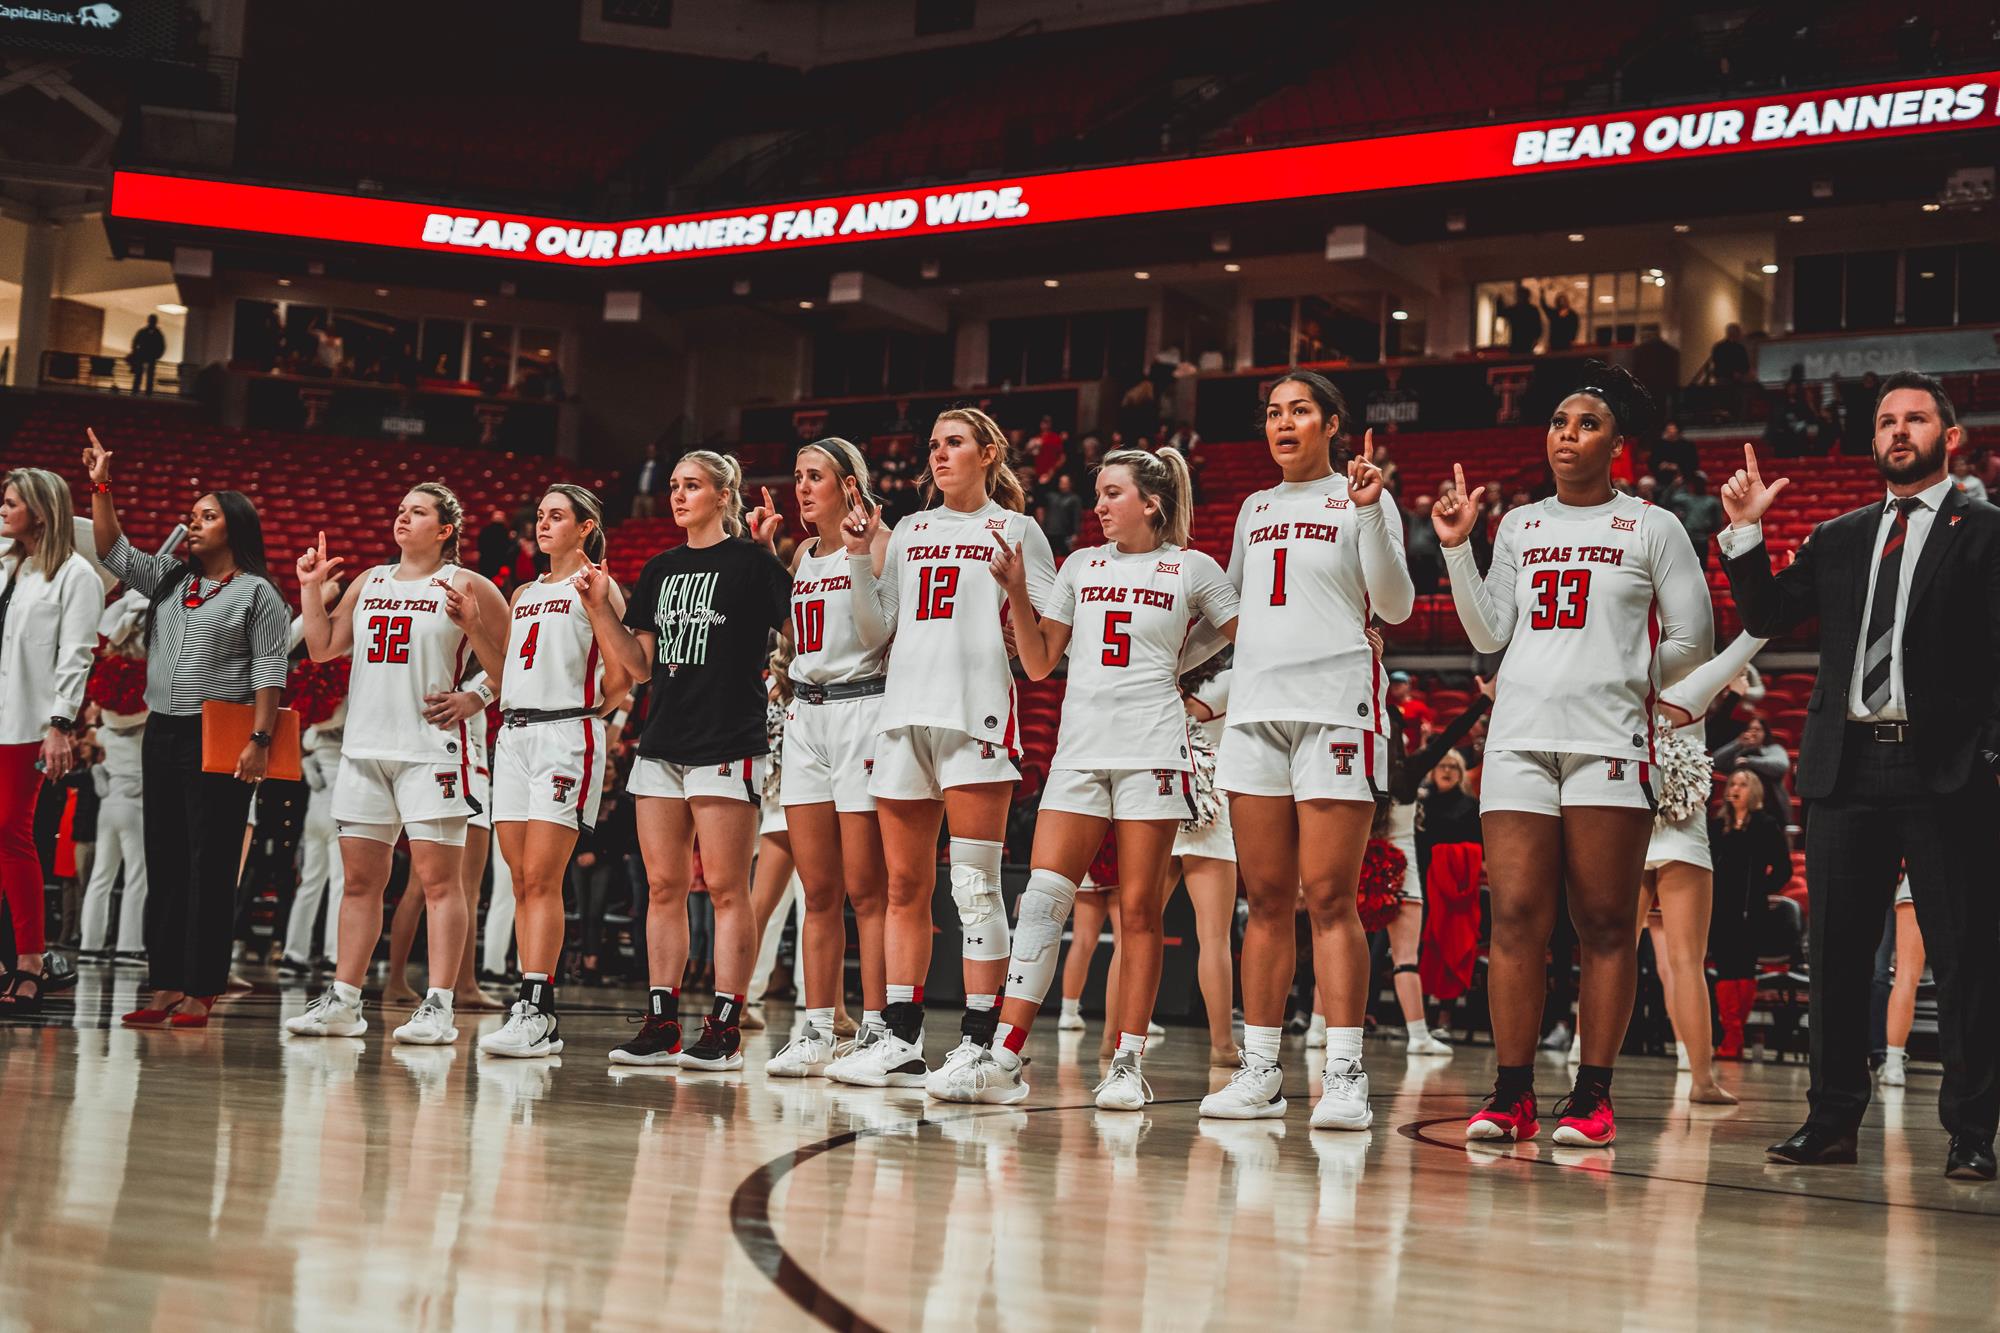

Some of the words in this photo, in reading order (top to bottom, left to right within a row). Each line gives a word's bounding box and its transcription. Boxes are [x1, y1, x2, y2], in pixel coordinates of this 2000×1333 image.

[1512, 121, 1635, 166] BEAR
[1643, 109, 1744, 153] OUR
[1751, 83, 1987, 141] BANNERS
[421, 213, 531, 251] BEAR
[535, 226, 617, 259] OUR
[618, 214, 768, 258] BANNERS
[770, 207, 838, 242] FAR
[839, 198, 919, 235] AND
[925, 186, 1029, 226] WIDE.
[1366, 401, 1419, 422] HONOR
[907, 545, 951, 562] TEXAS
[955, 544, 994, 562] TECH
[1249, 523, 1289, 546] TEXAS
[1294, 522, 1338, 543] TECH
[1522, 547, 1572, 567] TEXAS
[1578, 546, 1624, 566] TECH
[657, 572, 719, 615] MENTAL
[820, 575, 851, 592] TECH
[916, 566, 960, 621] 12
[1081, 586, 1128, 603] TEXAS
[1132, 588, 1174, 611] TECH
[1270, 548, 1287, 606] 1
[1531, 569, 1592, 630] 33
[363, 598, 402, 611] TEXAS
[404, 599, 438, 613] TECH
[542, 600, 572, 614] TECH
[795, 599, 825, 655] 10
[368, 615, 413, 664] 32
[520, 622, 540, 670] 4
[1101, 611, 1132, 667] 5
